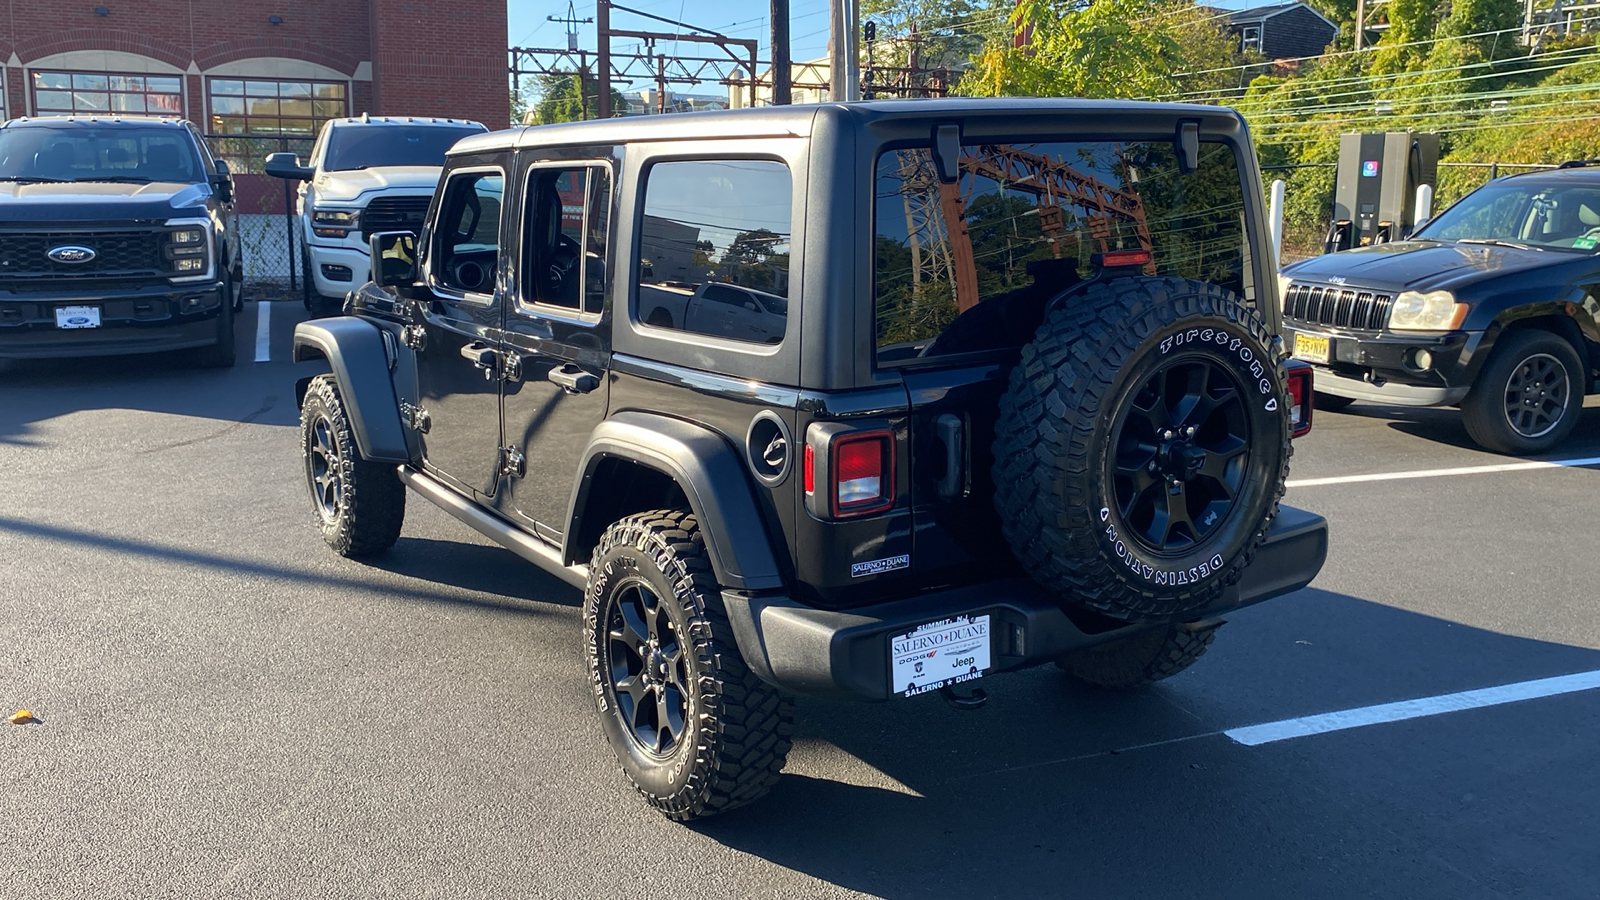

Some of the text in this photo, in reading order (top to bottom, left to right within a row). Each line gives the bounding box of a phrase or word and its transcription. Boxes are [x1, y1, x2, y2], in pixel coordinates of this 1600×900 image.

[59, 249, 85, 260] Ford
[1160, 328, 1271, 394] Firestone
[1106, 525, 1224, 586] DESTINATION
[587, 573, 608, 713] DESTINATION
[894, 623, 987, 656] SALERNO DUANE
[952, 656, 975, 668] Jeep
[904, 670, 983, 698] SALERNO DUANE
